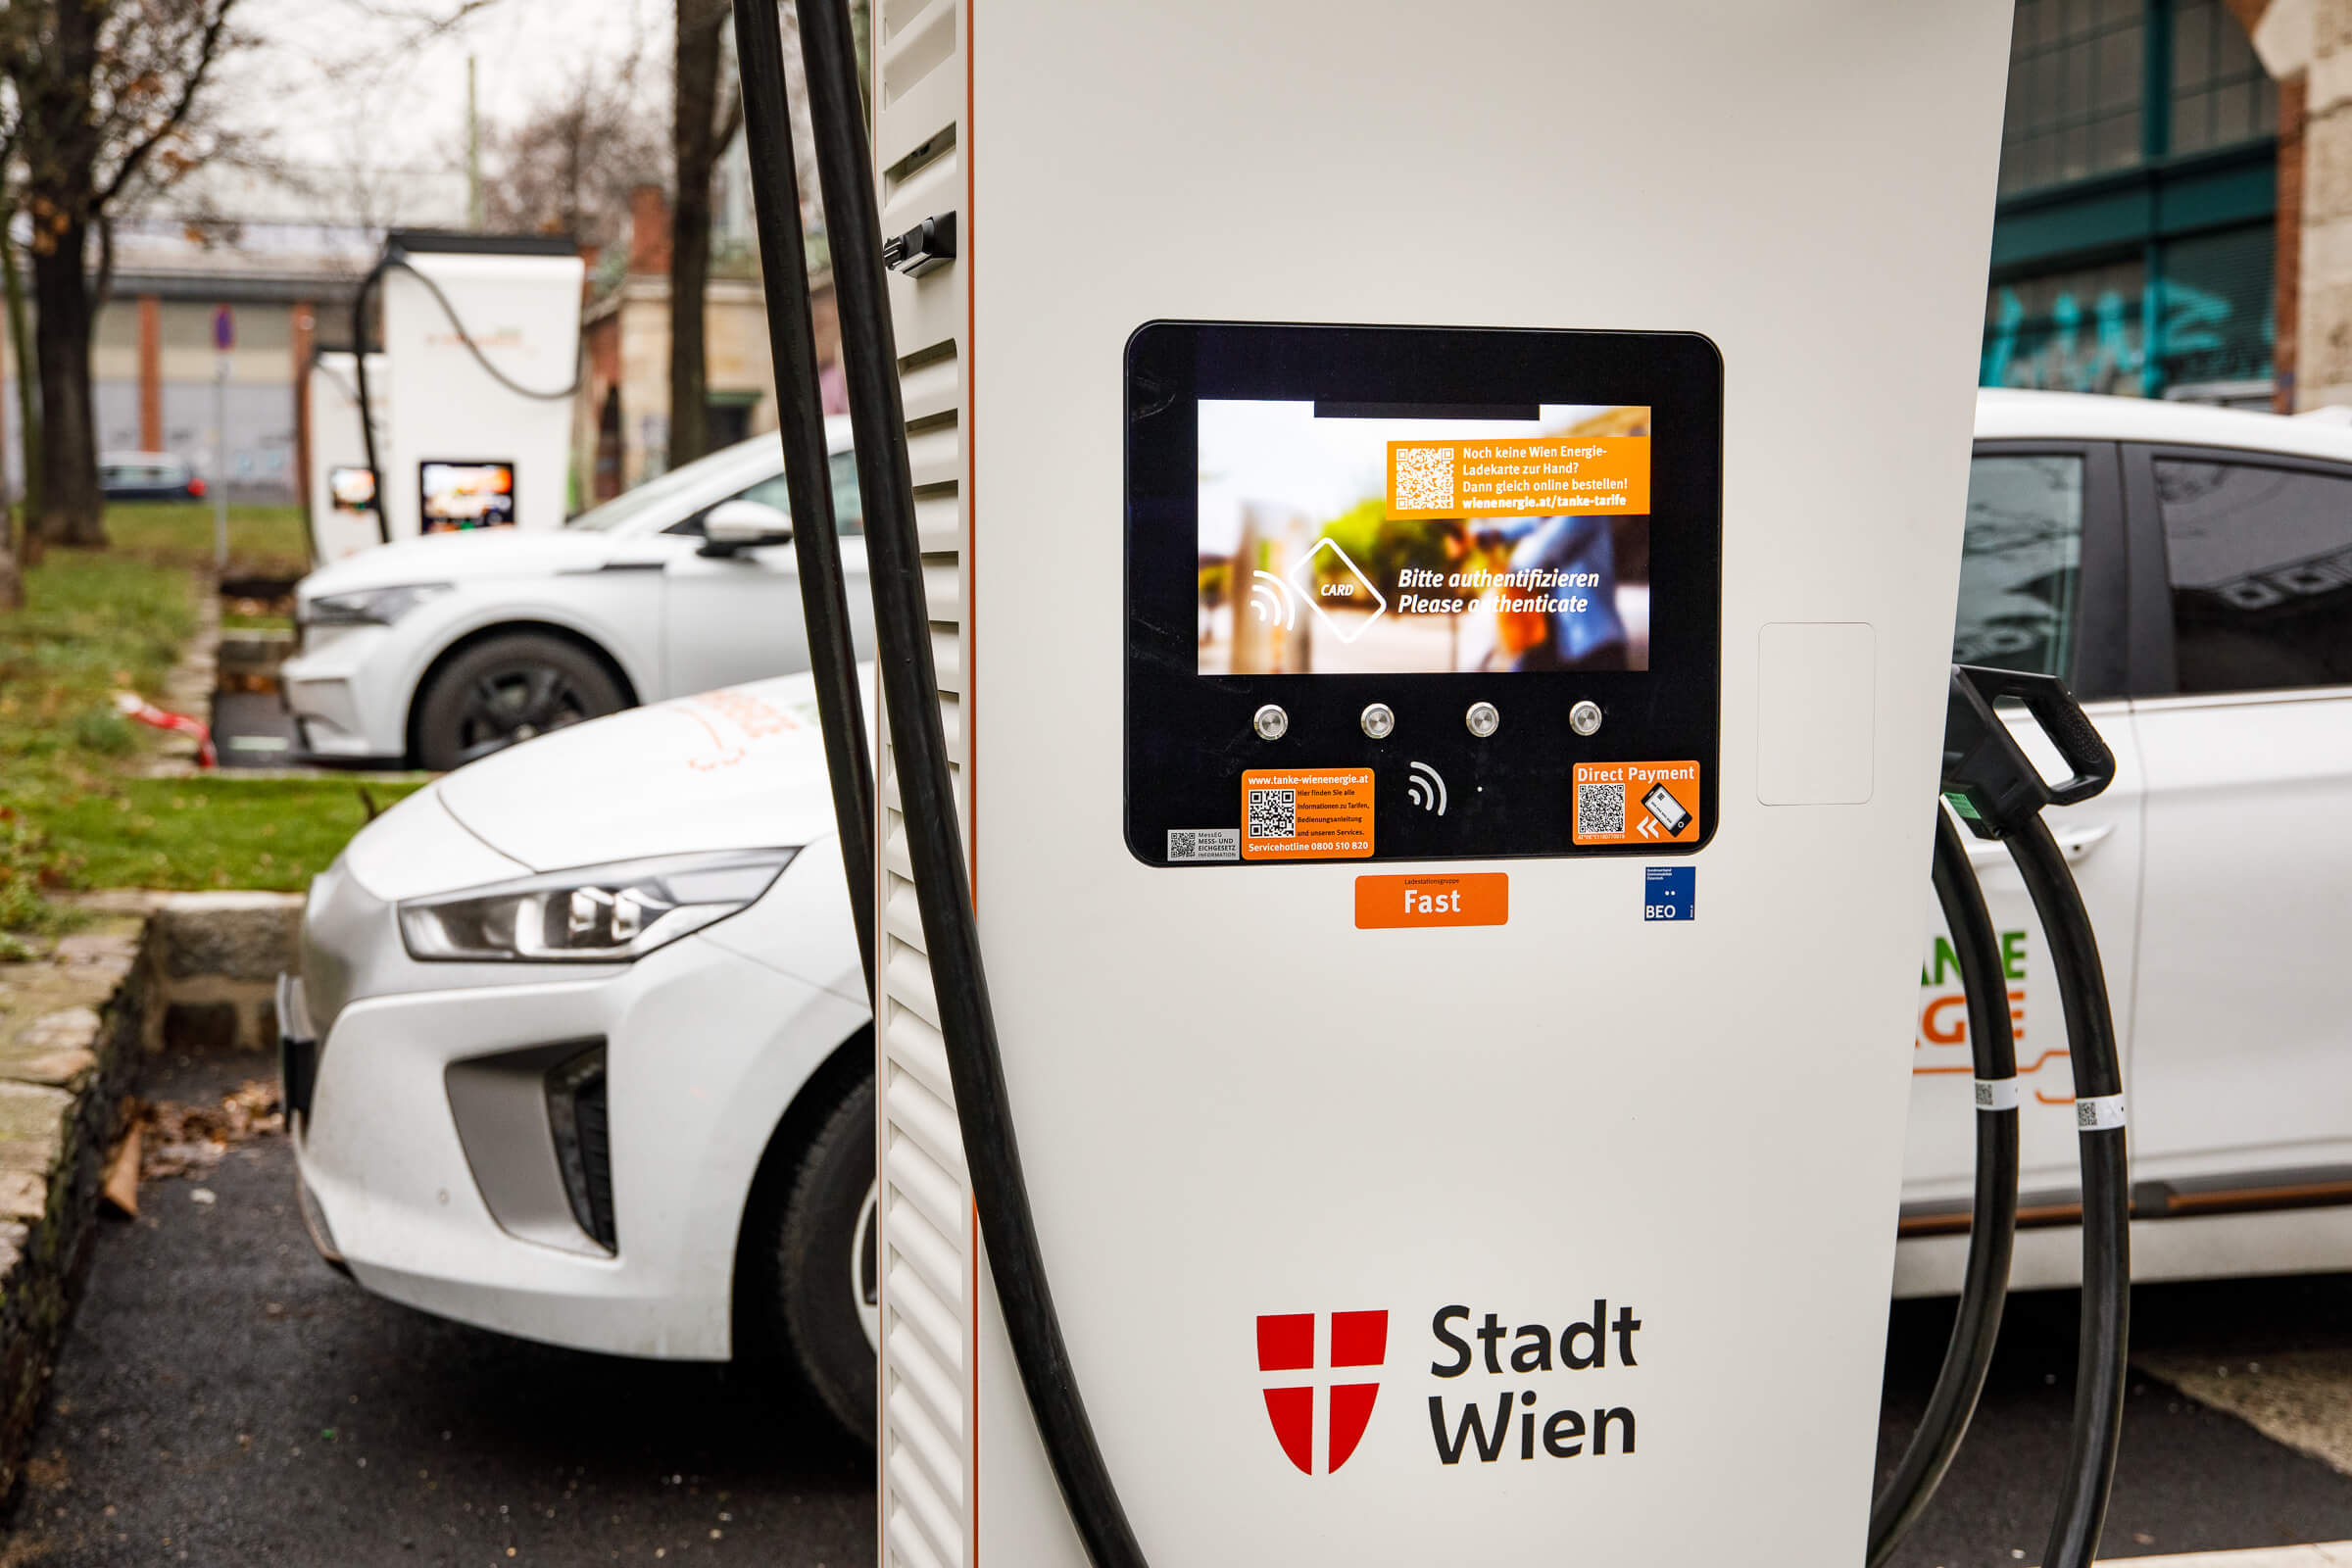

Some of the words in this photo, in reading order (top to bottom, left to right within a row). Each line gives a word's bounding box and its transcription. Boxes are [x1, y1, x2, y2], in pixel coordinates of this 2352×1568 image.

[1463, 447, 1492, 459] Noch
[1495, 446, 1526, 459] keine
[1529, 446, 1557, 458] Wien
[1560, 445, 1607, 460] Energie-
[1463, 464, 1520, 475] Ladekarte
[1522, 465, 1541, 474] zur
[1544, 462, 1579, 474] Hand?
[1463, 481, 1492, 493] Dann
[1495, 479, 1530, 495] gleich
[1533, 479, 1569, 492] online
[1572, 478, 1628, 491] bestellen!
[1462, 495, 1627, 510] wienenergie.at/tanke-tarife
[1397, 568, 1444, 587] Bitte
[1448, 568, 1599, 591] authentifizieren
[1320, 584, 1354, 597] CARD
[1397, 595, 1463, 613] Please
[1249, 774, 1369, 786] www.tanke-wienenergie.at
[1578, 767, 1624, 782] Direct
[1629, 766, 1694, 784] Payment
[1298, 815, 1362, 824] Bedienungsanleitung
[1249, 843, 1309, 853] Servicehotline
[1311, 842, 1334, 852] 0800
[1335, 841, 1350, 851] 510
[1404, 889, 1461, 913] Fast
[1431, 1298, 1642, 1378] Stadt
[1428, 1390, 1637, 1465] Wien
